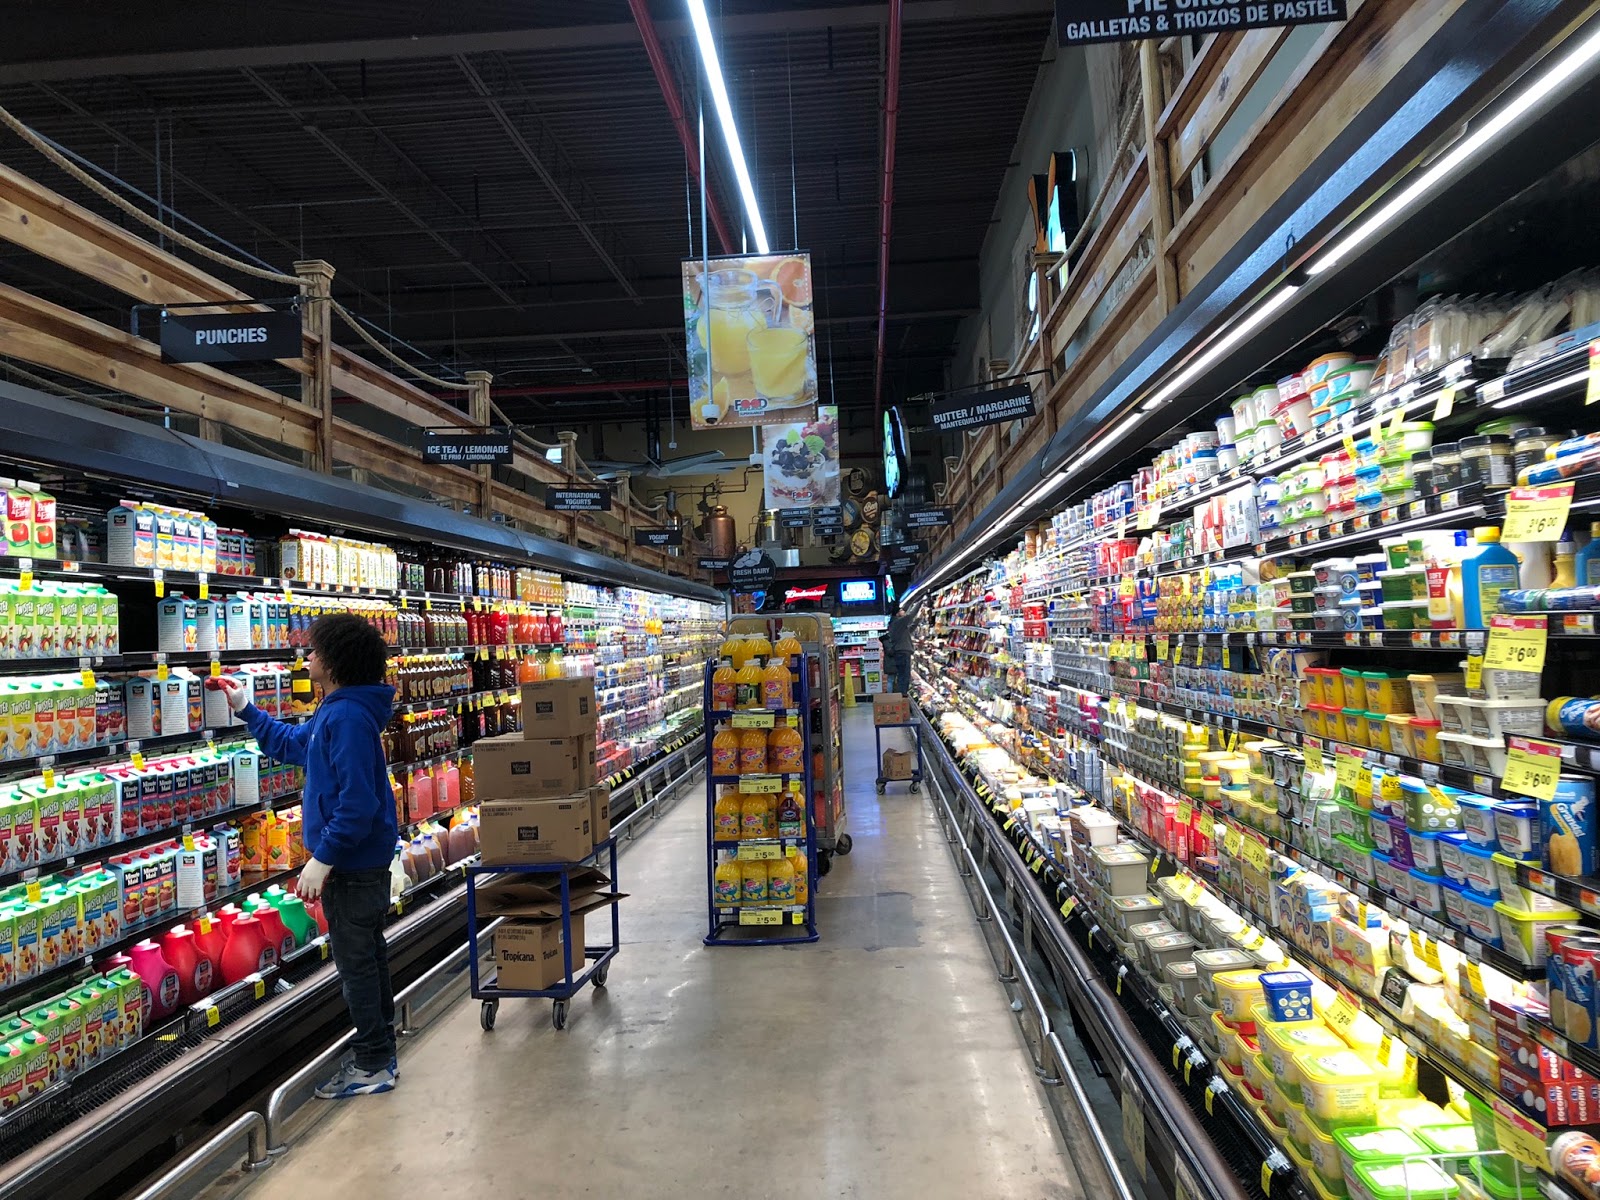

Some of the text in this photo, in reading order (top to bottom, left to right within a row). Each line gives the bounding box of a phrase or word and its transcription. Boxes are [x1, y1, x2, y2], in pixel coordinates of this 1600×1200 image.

[1066, 16, 1150, 40] GALLETAS
[1156, 15, 1169, 31] &
[1174, 7, 1241, 30] TROZOS
[1246, 5, 1268, 22] DE
[1274, 0, 1338, 20] PASTEL
[195, 327, 268, 345] PUNCHES
[934, 410, 968, 424] BUTTER
[977, 396, 1031, 414] MARGARINE
[940, 416, 984, 430] MANTEQUILLA
[989, 406, 1028, 420] MARGARINA
[428, 446, 440, 454] ICE
[442, 446, 458, 454] TEA
[465, 446, 508, 454] LEMONADE
[753, 568, 770, 576] DAIRY
[785, 590, 826, 598] Budweiser
[502, 950, 536, 962] Tropicana
